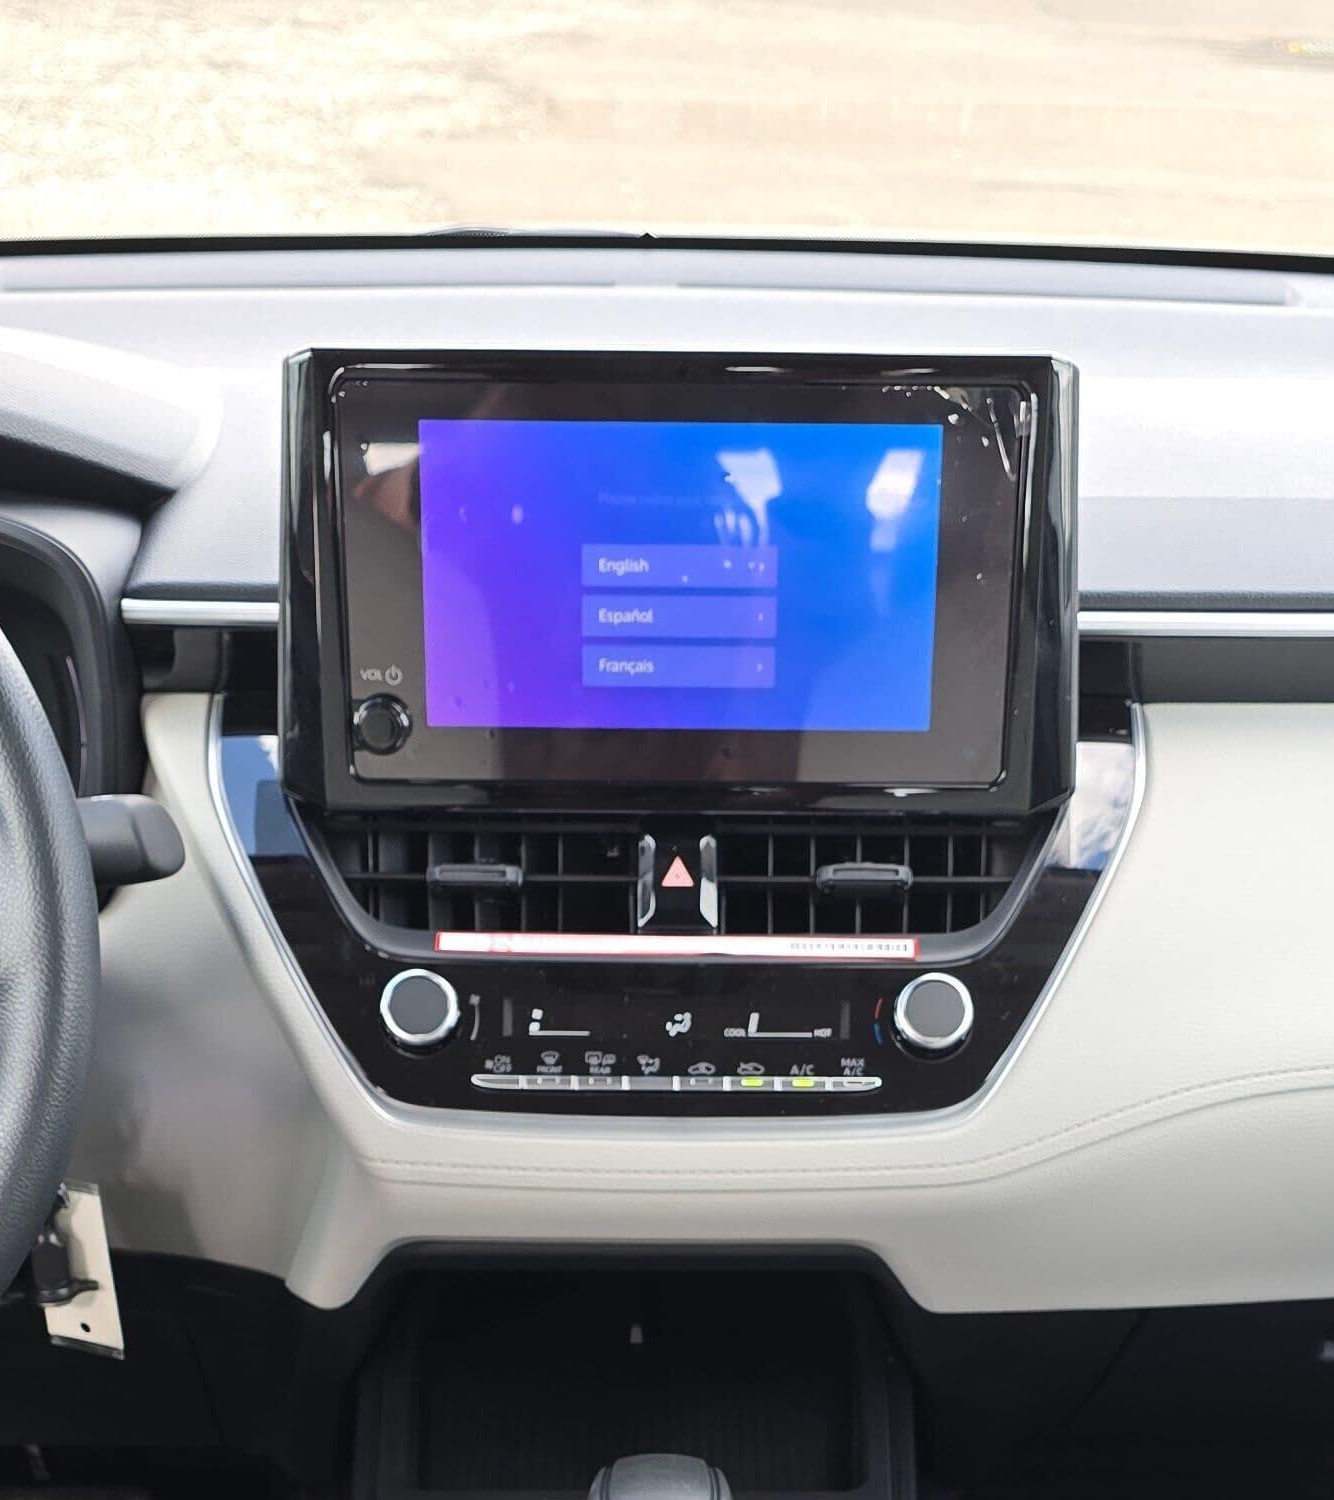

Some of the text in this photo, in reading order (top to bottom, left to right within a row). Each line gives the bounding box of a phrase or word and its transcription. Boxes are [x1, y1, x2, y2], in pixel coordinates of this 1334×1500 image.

[598, 557, 649, 577] English
[598, 608, 653, 626] Español
[598, 657, 654, 677] Français
[359, 668, 383, 681] VOL
[839, 1057, 865, 1068] MAX
[789, 1063, 816, 1076] A/C
[842, 1066, 865, 1076] A/C
